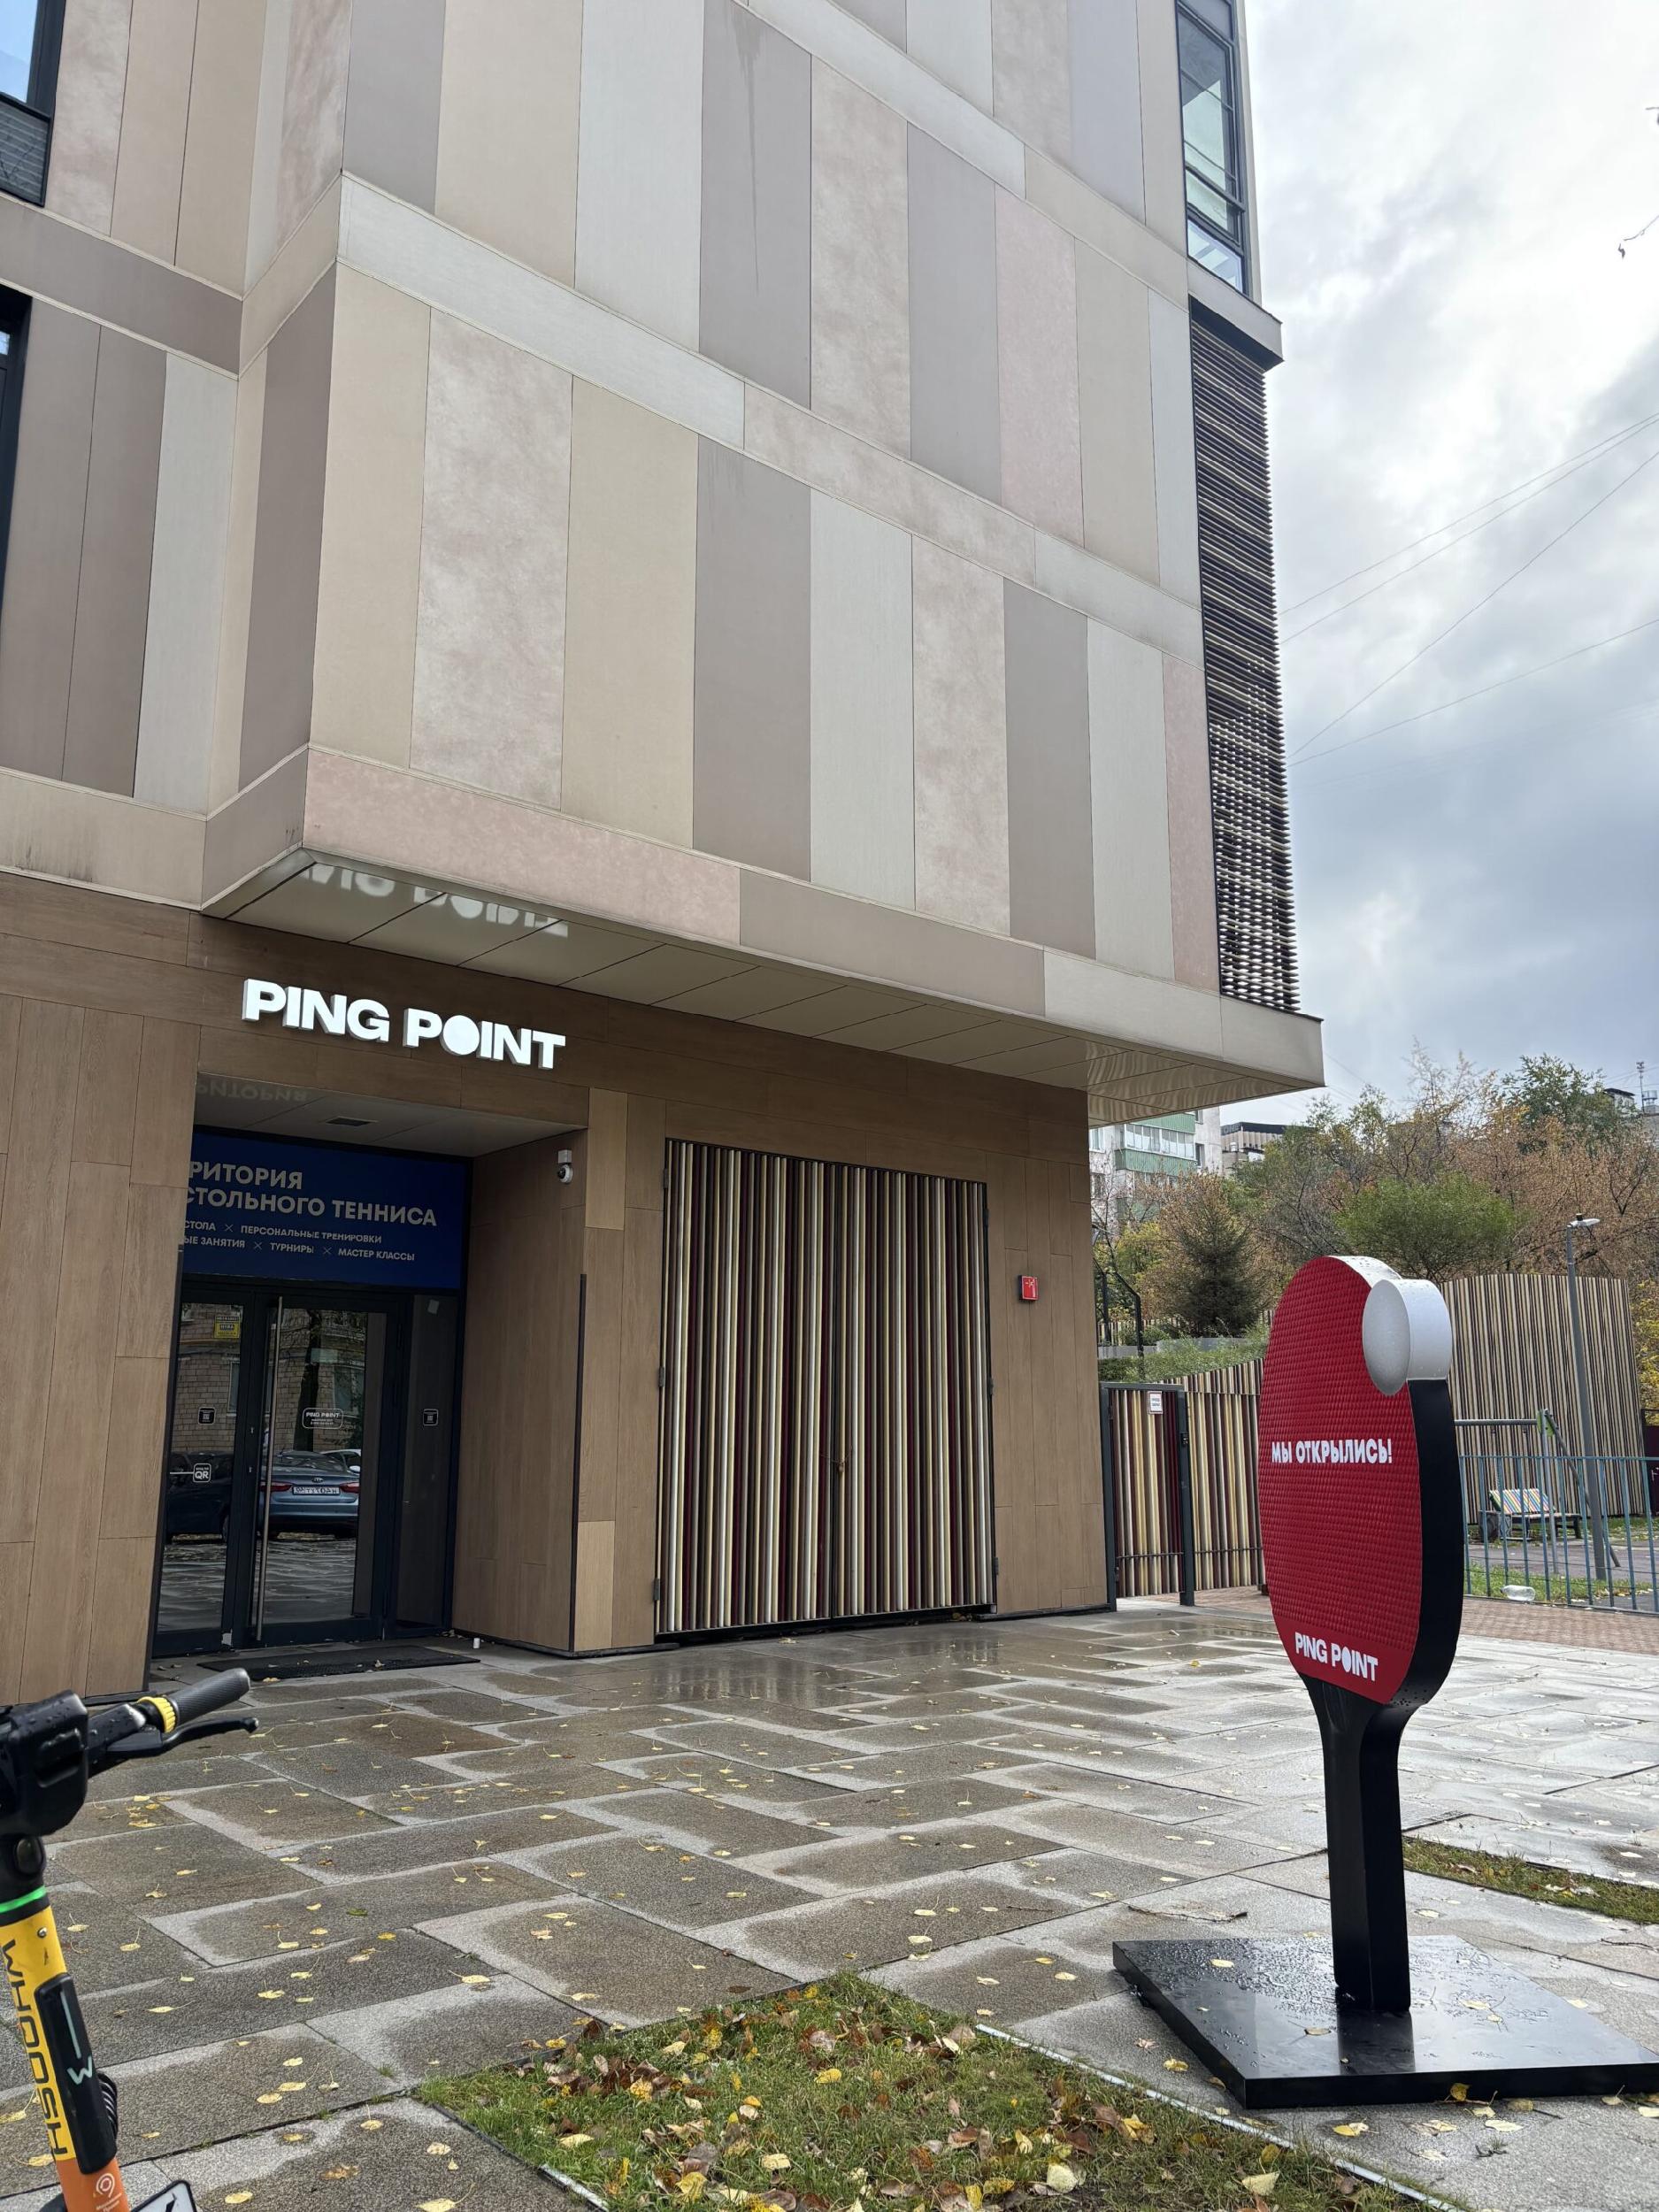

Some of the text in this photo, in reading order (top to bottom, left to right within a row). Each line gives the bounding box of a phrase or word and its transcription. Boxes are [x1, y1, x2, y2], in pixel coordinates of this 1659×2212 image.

[242, 978, 566, 1070] PING POINT
[188, 1161, 303, 1190] РИТОРИЯ
[332, 1200, 438, 1227] ТЕННИСА
[241, 1225, 319, 1239] ПЕРСОНАЛЬНЫЕ
[321, 1231, 382, 1244] ТРЕНИРОВКИ
[200, 1236, 246, 1248] ЗАНЯТИЯ
[270, 1242, 314, 1254] ТУРНИРЫ
[338, 1248, 374, 1259] МАСТЕР
[376, 1251, 415, 1262] КЛАССЫ
[1271, 1438, 1393, 1464] МЫ ОТКРЫЛИСЬ!
[195, 1471, 210, 1480] QR
[1294, 1632, 1379, 1682] PING POINT
[3, 1939, 68, 2155] WHOOSH
